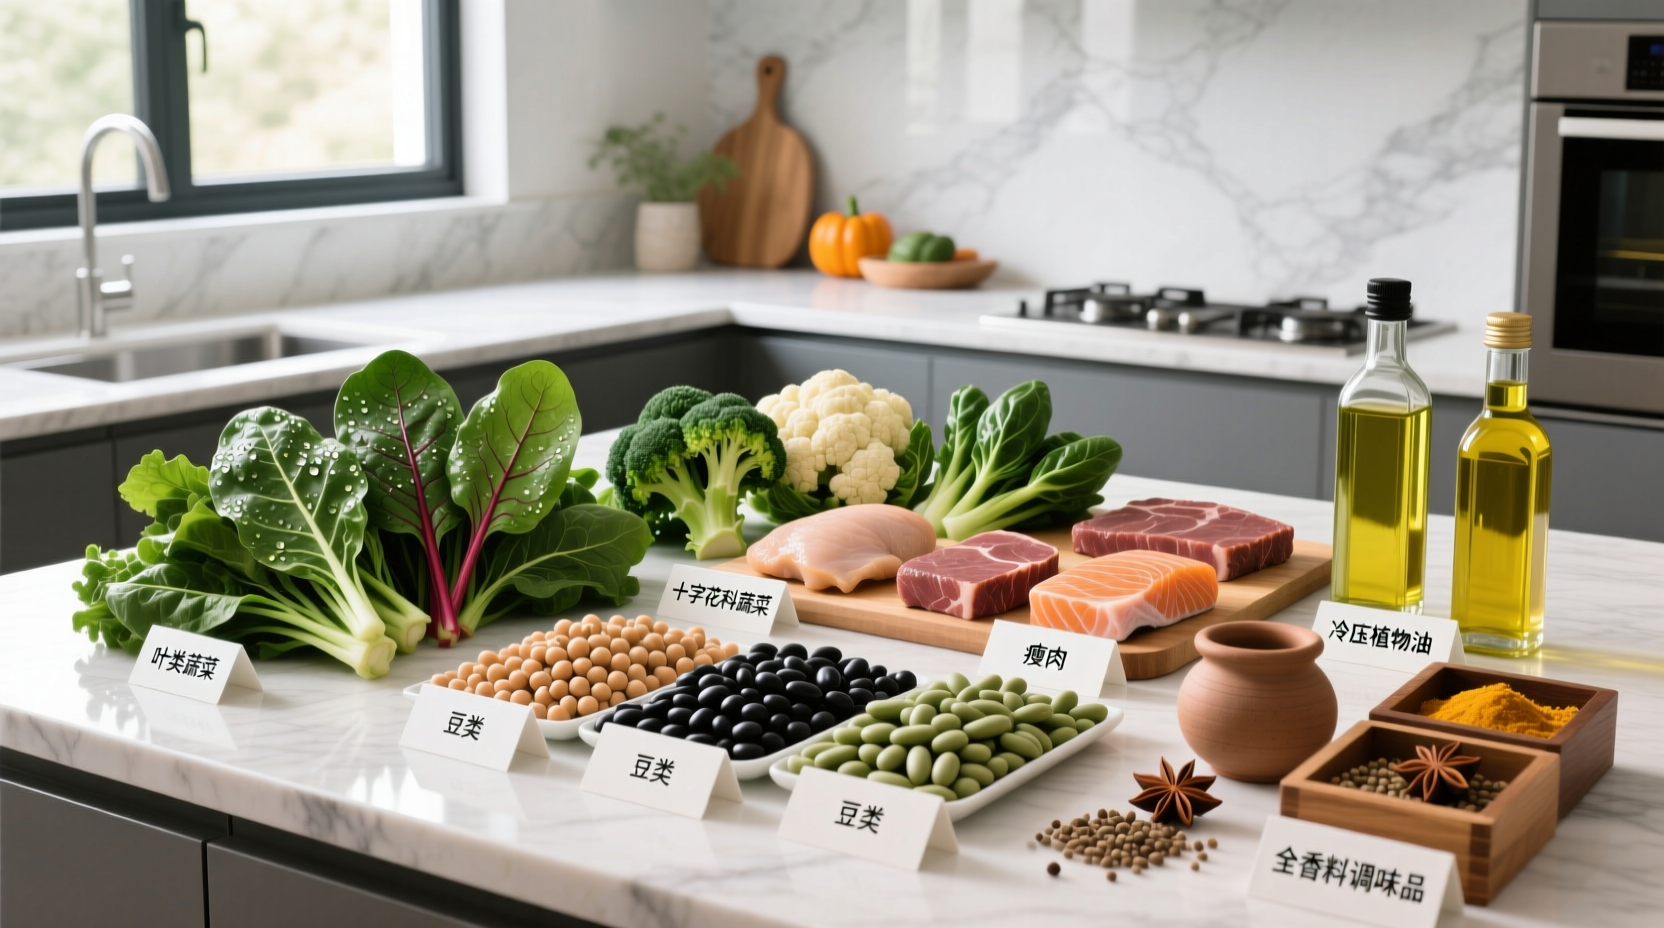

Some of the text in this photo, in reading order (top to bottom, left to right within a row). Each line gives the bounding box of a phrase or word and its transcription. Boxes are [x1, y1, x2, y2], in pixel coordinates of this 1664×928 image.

[672, 581, 773, 617] 十字花科蔬菜
[1328, 619, 1433, 655] 冷压植物油
[151, 646, 221, 681] 叶类蔬菜
[1023, 642, 1068, 671] 瘦肉
[443, 711, 485, 741] 豆类
[629, 754, 675, 786] 豆类
[834, 800, 884, 834] 豆类
[1272, 846, 1425, 903] 全香料调味品
